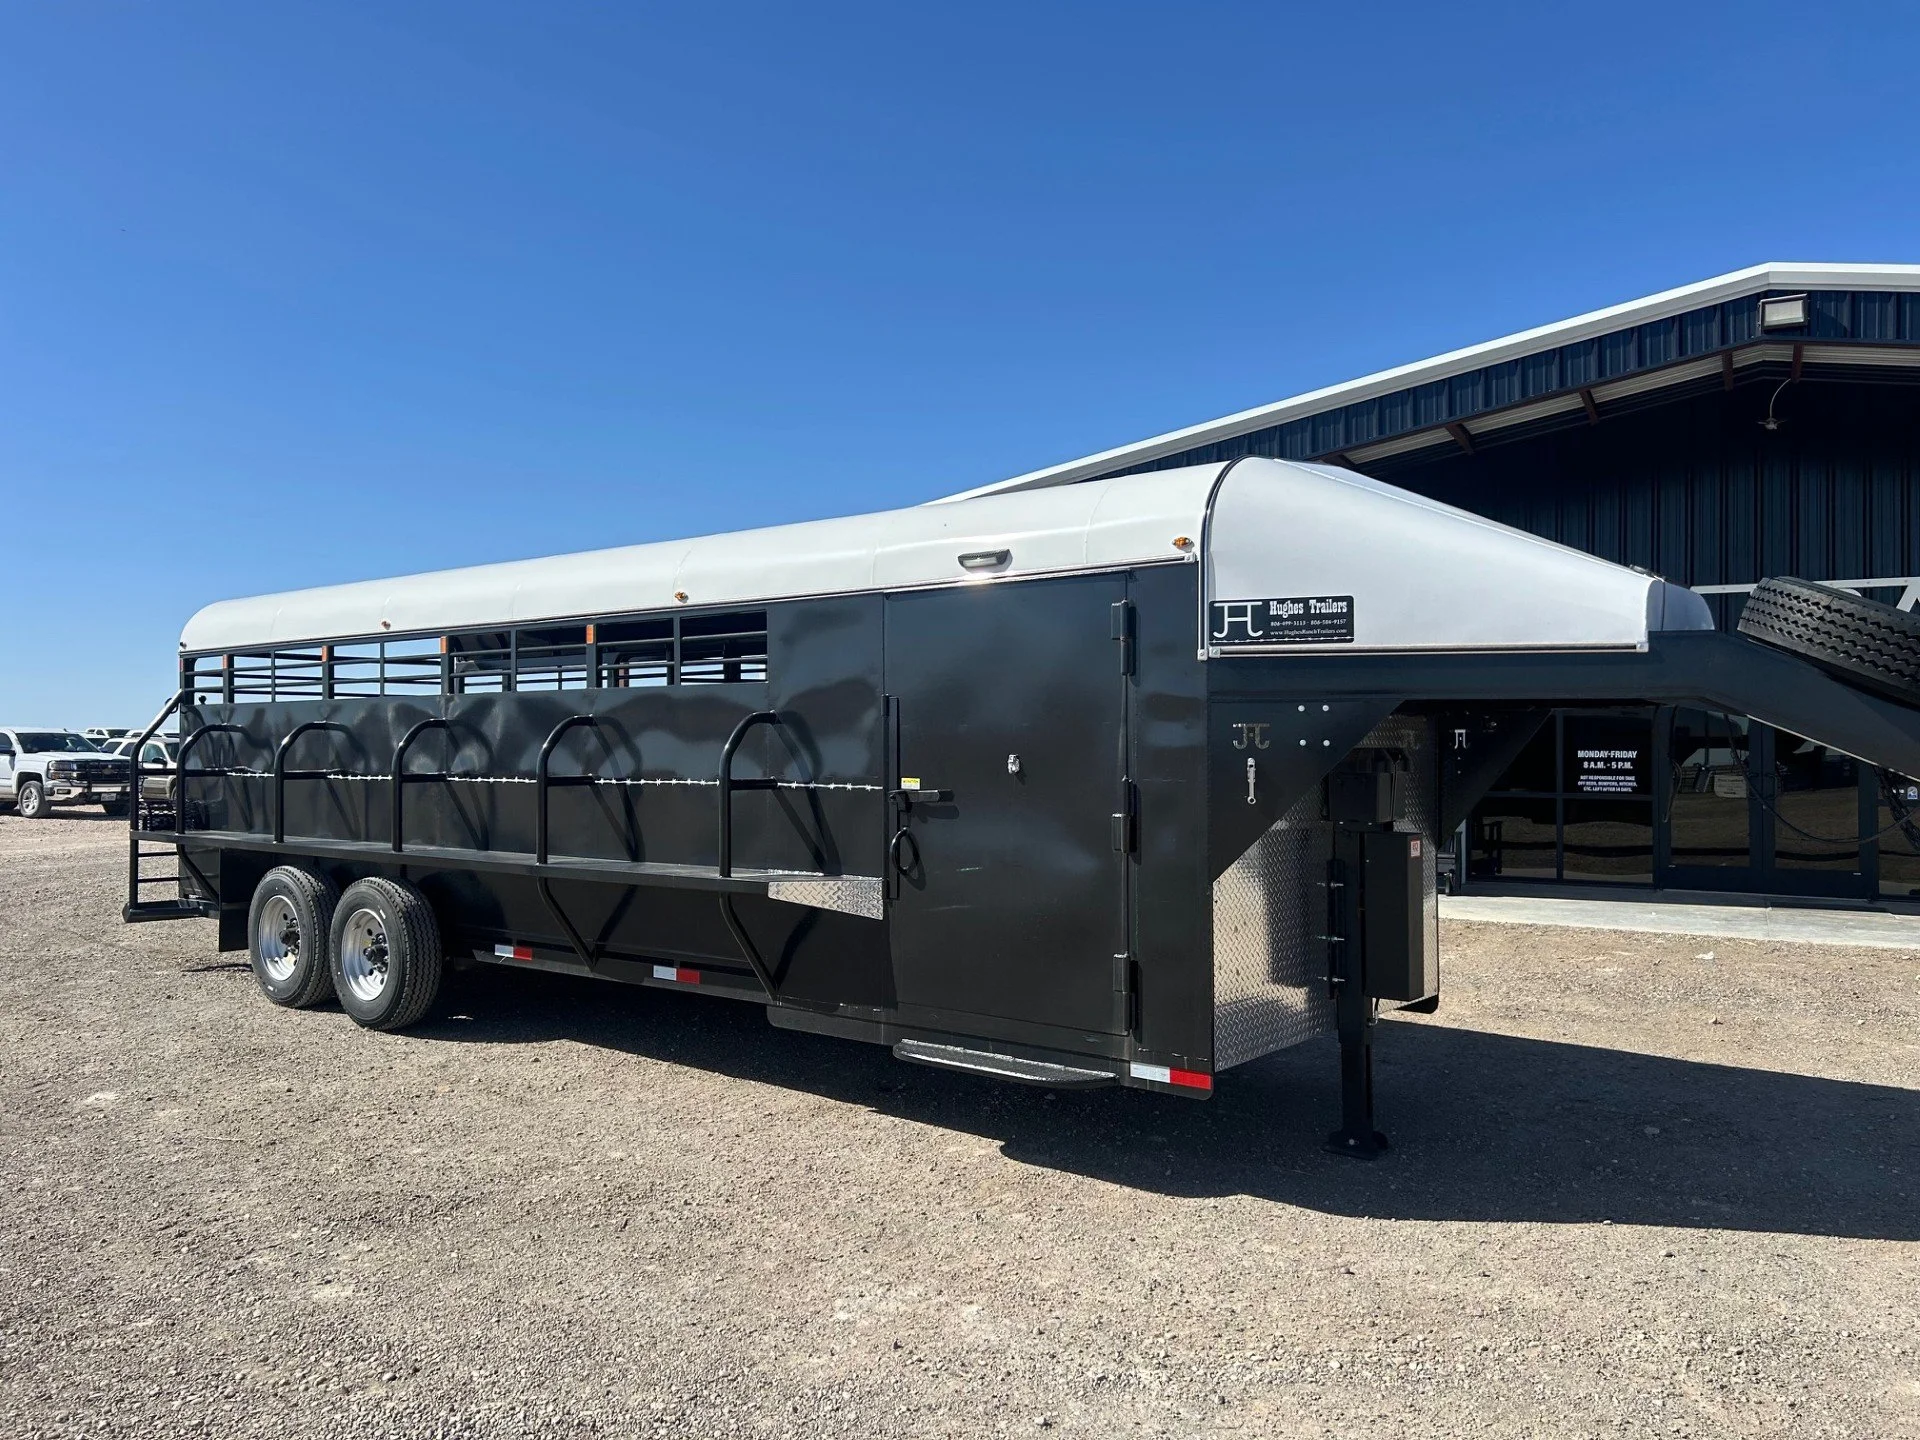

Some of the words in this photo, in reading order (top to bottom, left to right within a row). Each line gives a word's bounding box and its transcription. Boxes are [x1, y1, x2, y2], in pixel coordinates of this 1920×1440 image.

[1269, 600, 1304, 618] Hughes
[1309, 599, 1347, 613] Trailers
[1577, 750, 1638, 758] MONDAY-FRIDAY
[1583, 761, 1589, 769] 8
[1589, 761, 1606, 769] A.M.
[1611, 761, 1617, 769] 5
[1617, 761, 1633, 769] P.M.
